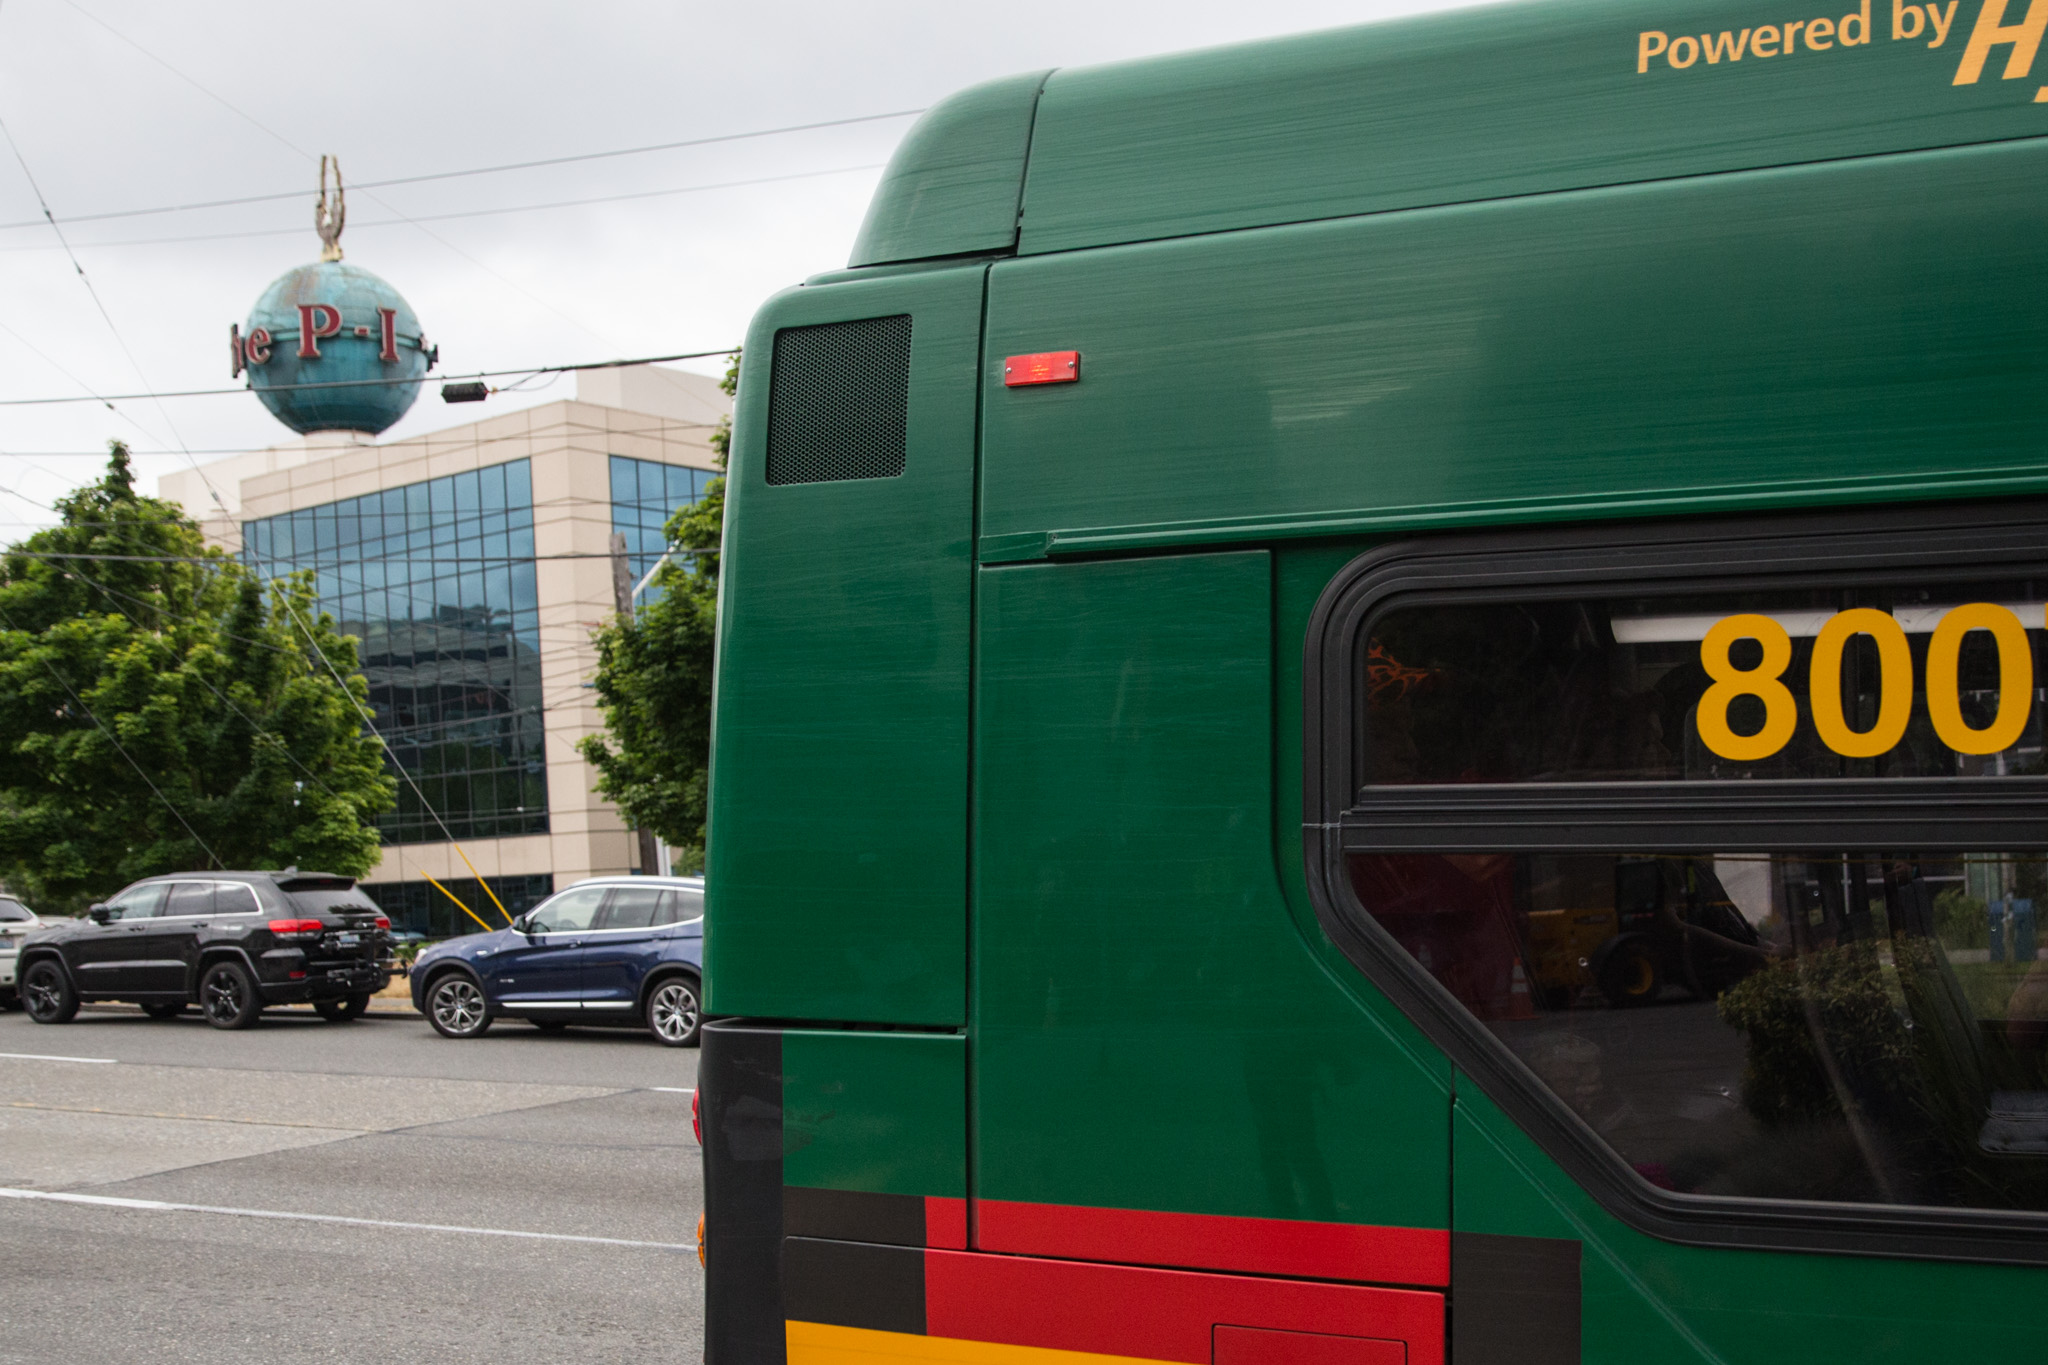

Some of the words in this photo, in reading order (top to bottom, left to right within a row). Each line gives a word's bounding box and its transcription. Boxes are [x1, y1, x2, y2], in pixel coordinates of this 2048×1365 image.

[1637, 0, 1871, 73] Powered
[1892, 0, 1959, 48] by
[1952, 0, 2048, 103] H
[297, 304, 400, 362] P-I
[1696, 603, 2048, 761] 800
